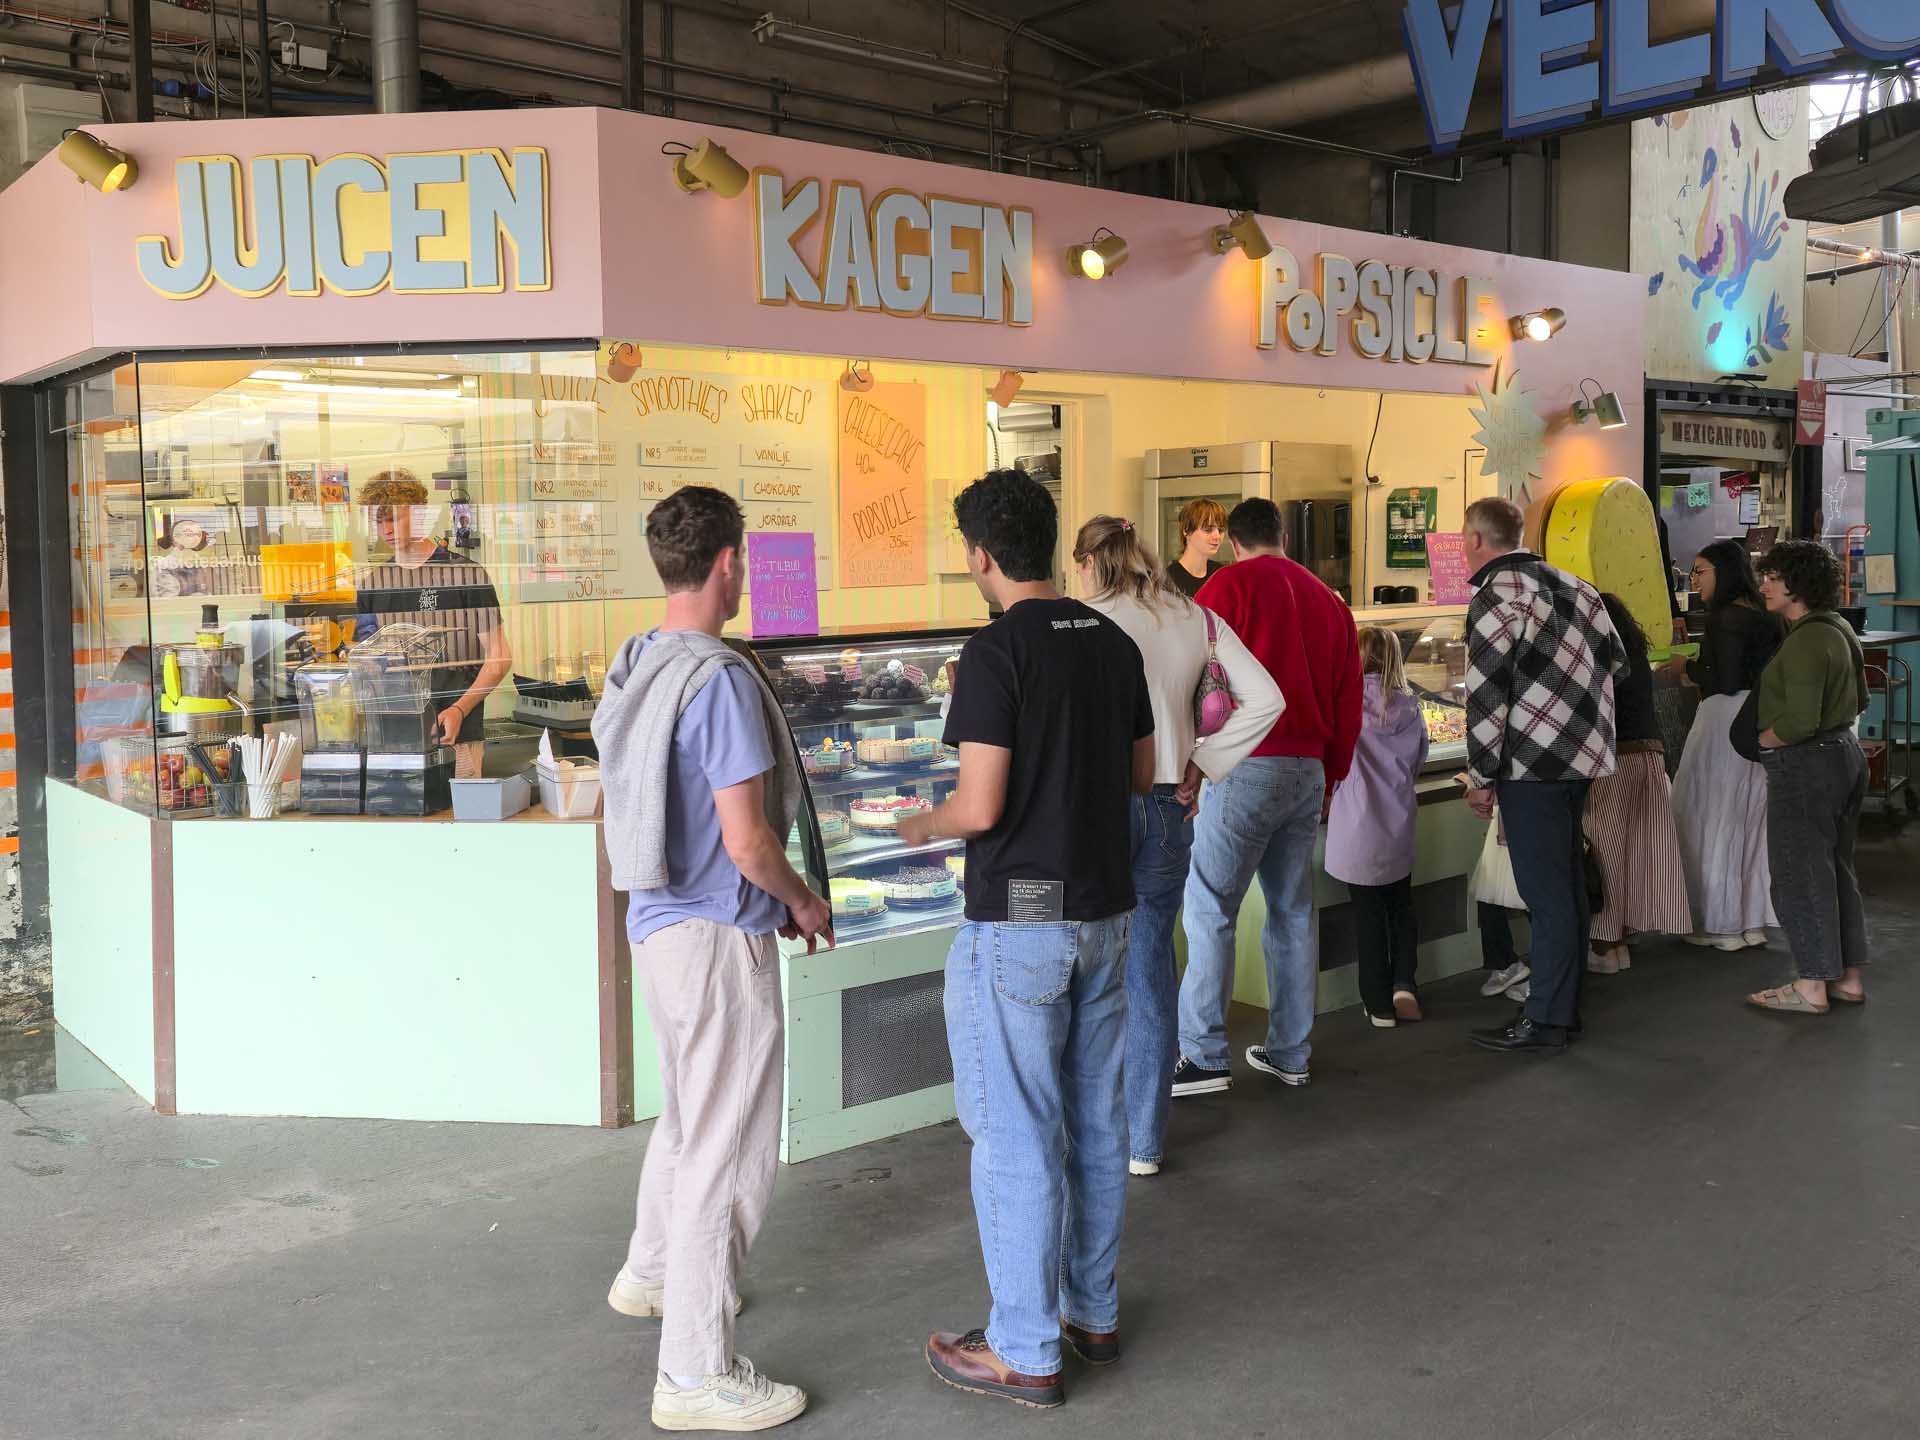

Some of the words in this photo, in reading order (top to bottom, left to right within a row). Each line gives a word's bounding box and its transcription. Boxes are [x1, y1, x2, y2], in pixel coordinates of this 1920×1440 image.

[136, 146, 553, 300] JUICEN
[753, 166, 1033, 327] KAGEN
[630, 376, 728, 424] SMOOTHIES
[741, 383, 812, 424] SHAKES
[754, 448, 792, 467] VANILJE
[844, 395, 926, 475] CHEESECAKE
[1672, 422, 1733, 447] MEXICAN
[1735, 428, 1767, 450] FOOD
[753, 482, 803, 497] CHOKOLADE
[852, 486, 918, 543] POPSICLE
